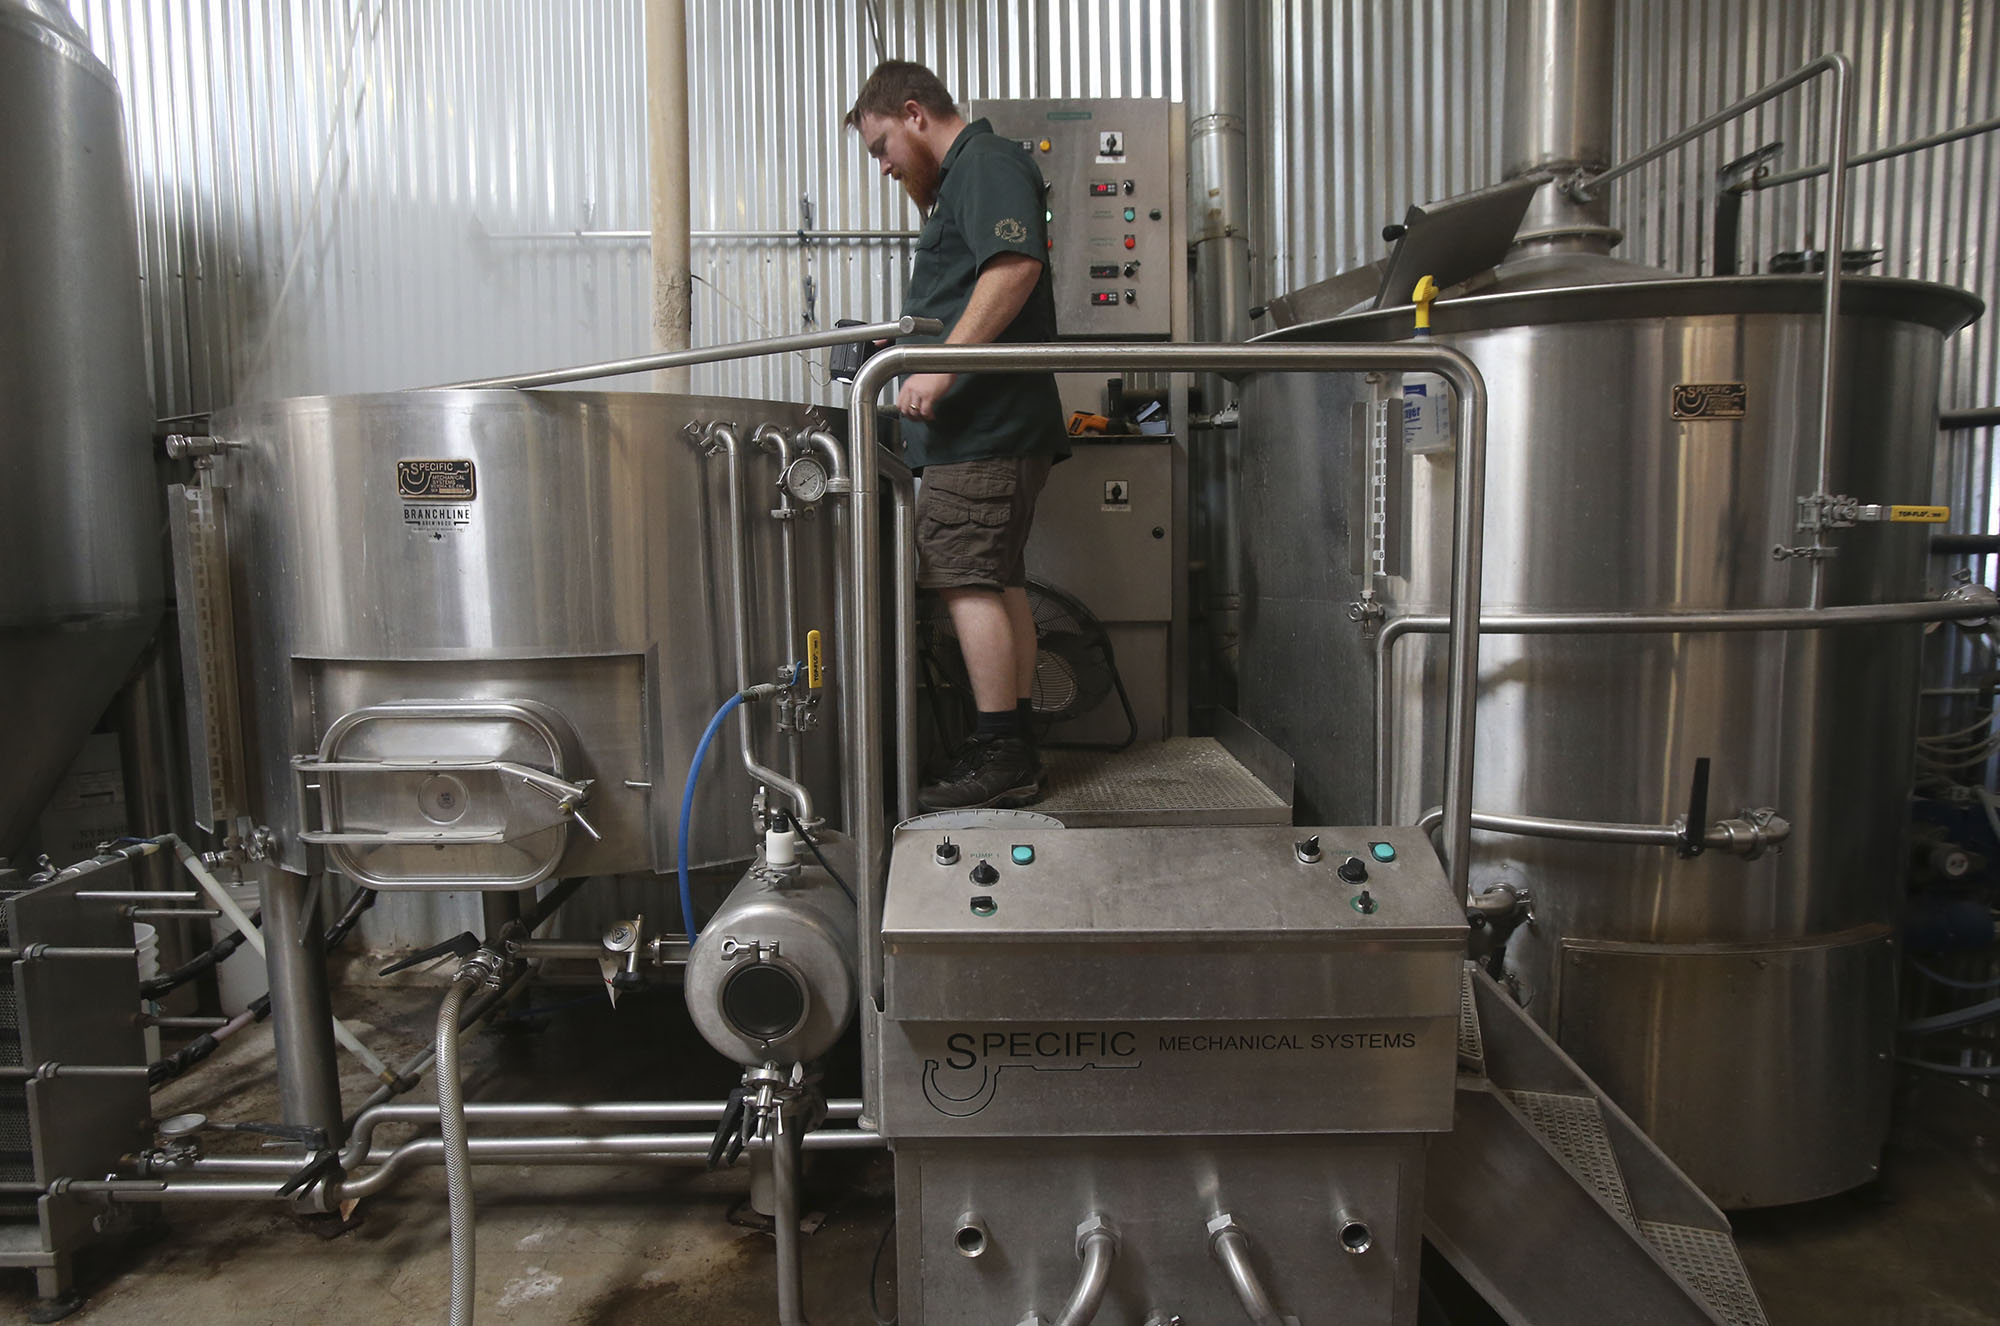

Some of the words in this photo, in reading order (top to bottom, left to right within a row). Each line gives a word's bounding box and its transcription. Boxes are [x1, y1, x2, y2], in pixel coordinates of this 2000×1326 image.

[411, 463, 453, 474] SPECIFIC
[404, 509, 470, 519] BRANCHLINE
[1159, 1035, 1304, 1050] MECHANICAL
[1311, 1033, 1416, 1049] SYSTEMS
[946, 1032, 1136, 1070] SPECIFIC
